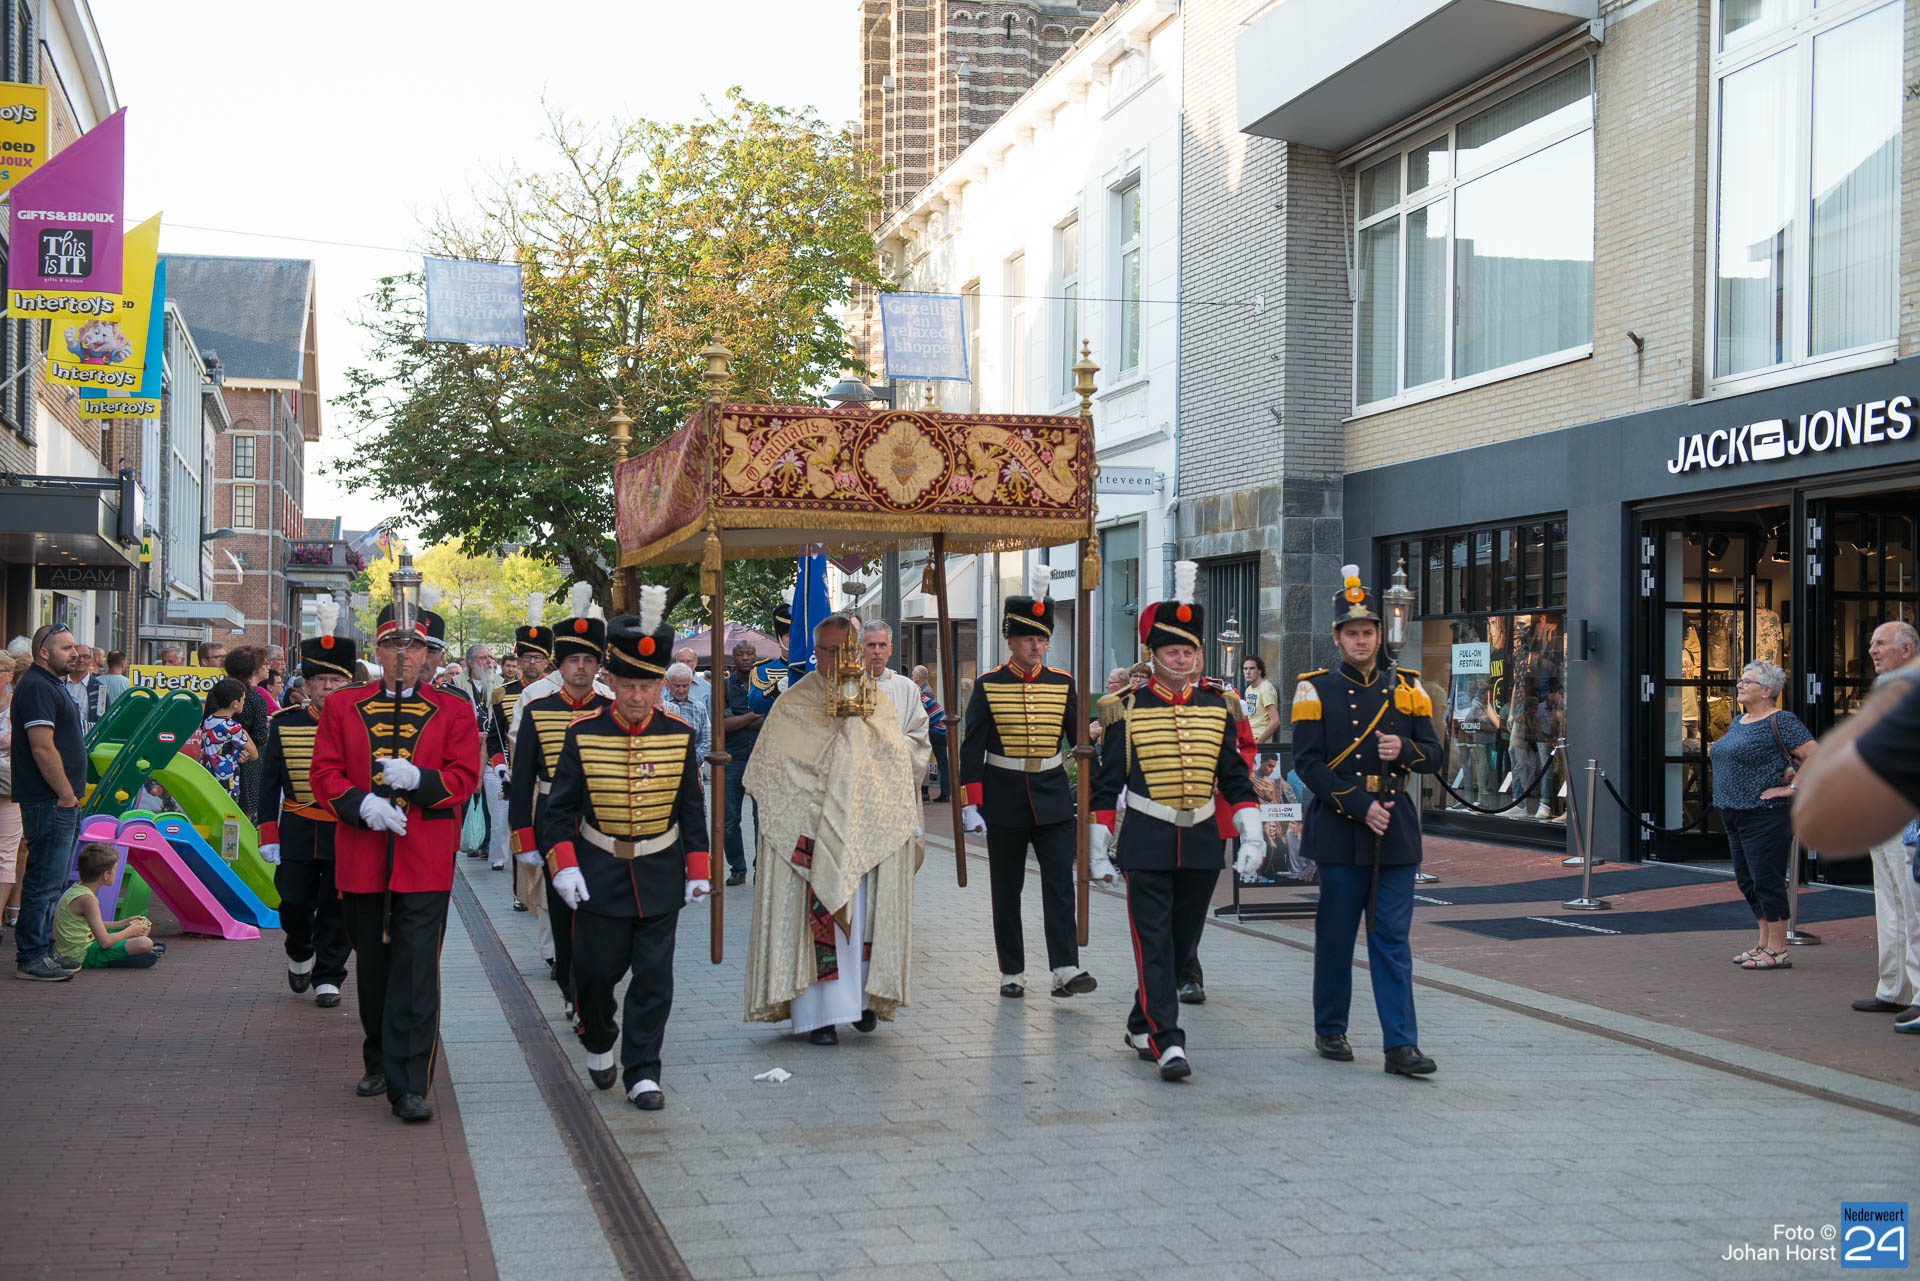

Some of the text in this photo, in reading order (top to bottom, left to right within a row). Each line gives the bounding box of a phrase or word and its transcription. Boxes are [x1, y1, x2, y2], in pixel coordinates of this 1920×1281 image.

[0, 104, 37, 124] oys
[43, 230, 86, 257] This
[57, 255, 87, 275] IT
[14, 292, 114, 315] Intertoys
[887, 299, 956, 321] Gezellig
[889, 321, 948, 339] relaxed
[912, 317, 930, 327] en
[51, 362, 135, 386] Intertoys
[84, 400, 154, 415] Intertoys
[1667, 395, 1912, 474] JACK JONES
[1099, 475, 1151, 486] tteveen
[51, 568, 116, 583] ADAM
[1458, 650, 1482, 658] FULL-ON
[1458, 660, 1484, 668] FESTIVAL
[132, 669, 225, 693] Interto
